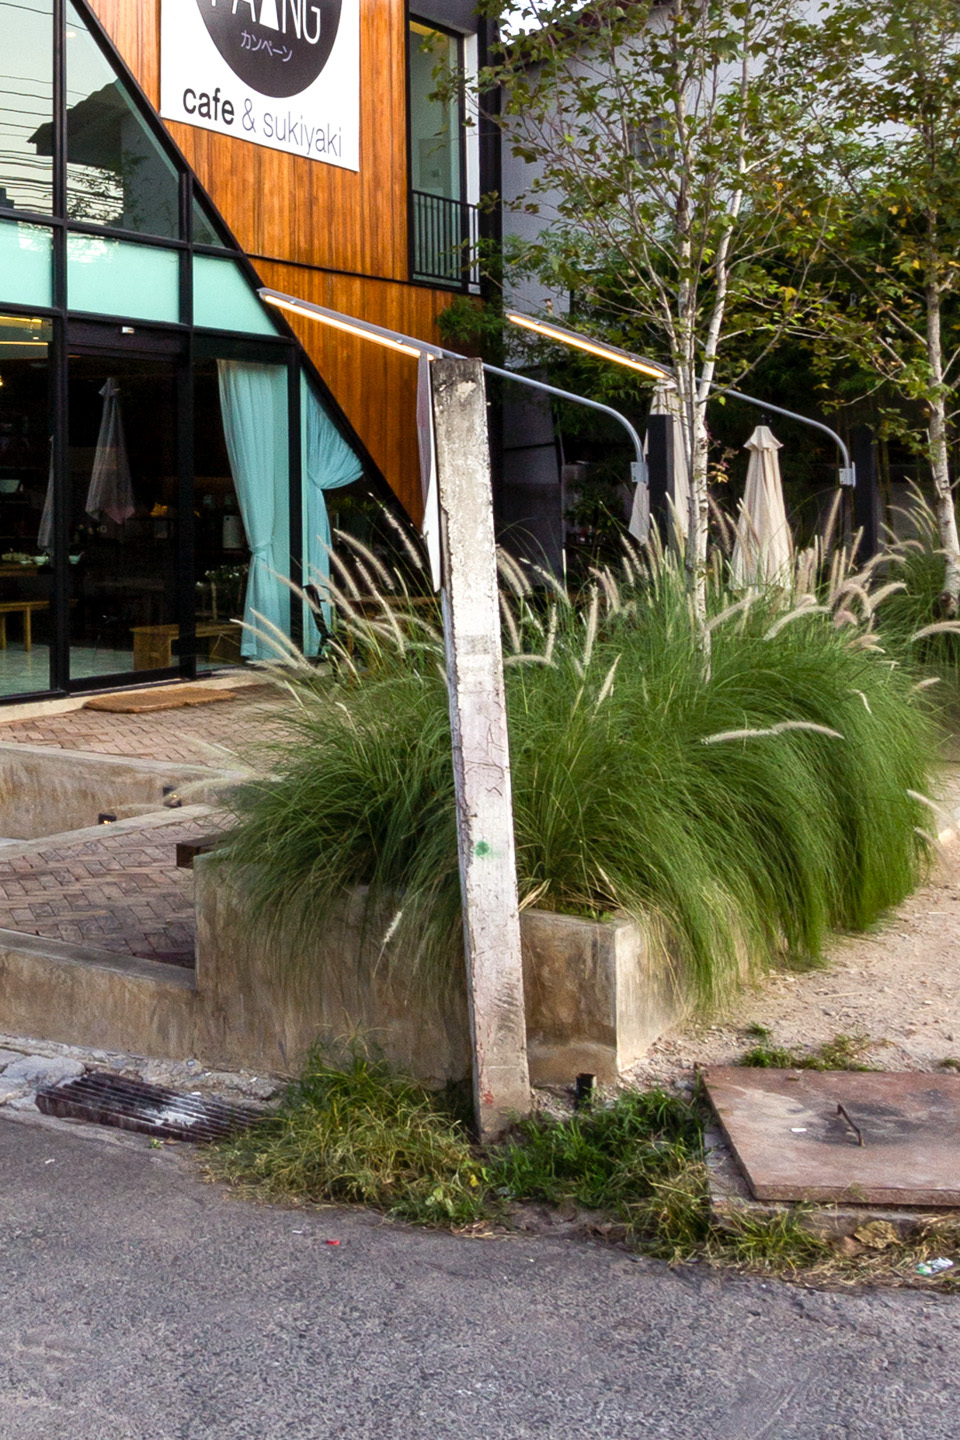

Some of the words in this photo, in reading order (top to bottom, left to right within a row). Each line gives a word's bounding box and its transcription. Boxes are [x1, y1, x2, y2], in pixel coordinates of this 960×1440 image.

[183, 87, 235, 125] cafe
[241, 98, 257, 133] &
[263, 111, 342, 158] sukiyaki
